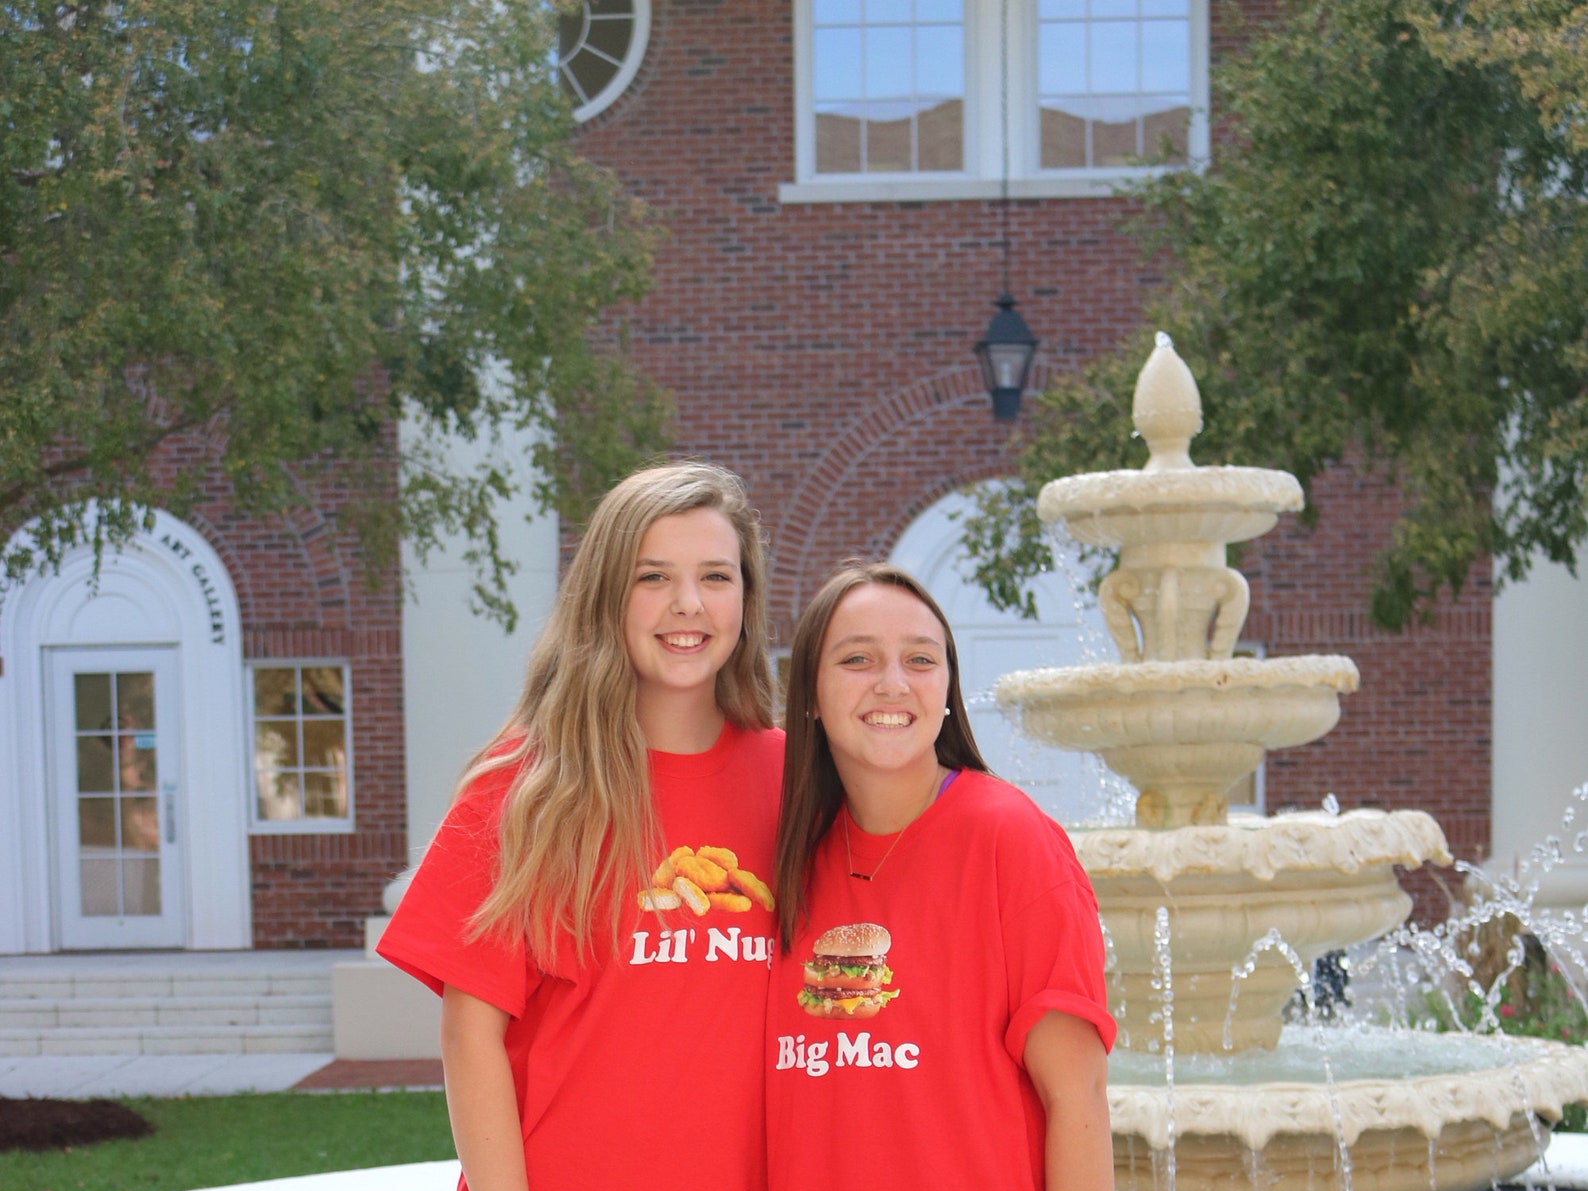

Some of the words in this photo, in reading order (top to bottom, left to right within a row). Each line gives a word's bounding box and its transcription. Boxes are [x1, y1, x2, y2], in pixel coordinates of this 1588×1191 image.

[161, 533, 192, 560] ART
[192, 563, 225, 645] GALLERY
[629, 928, 696, 965] Lil'
[775, 1034, 830, 1077] Big
[835, 1032, 920, 1069] Mac
